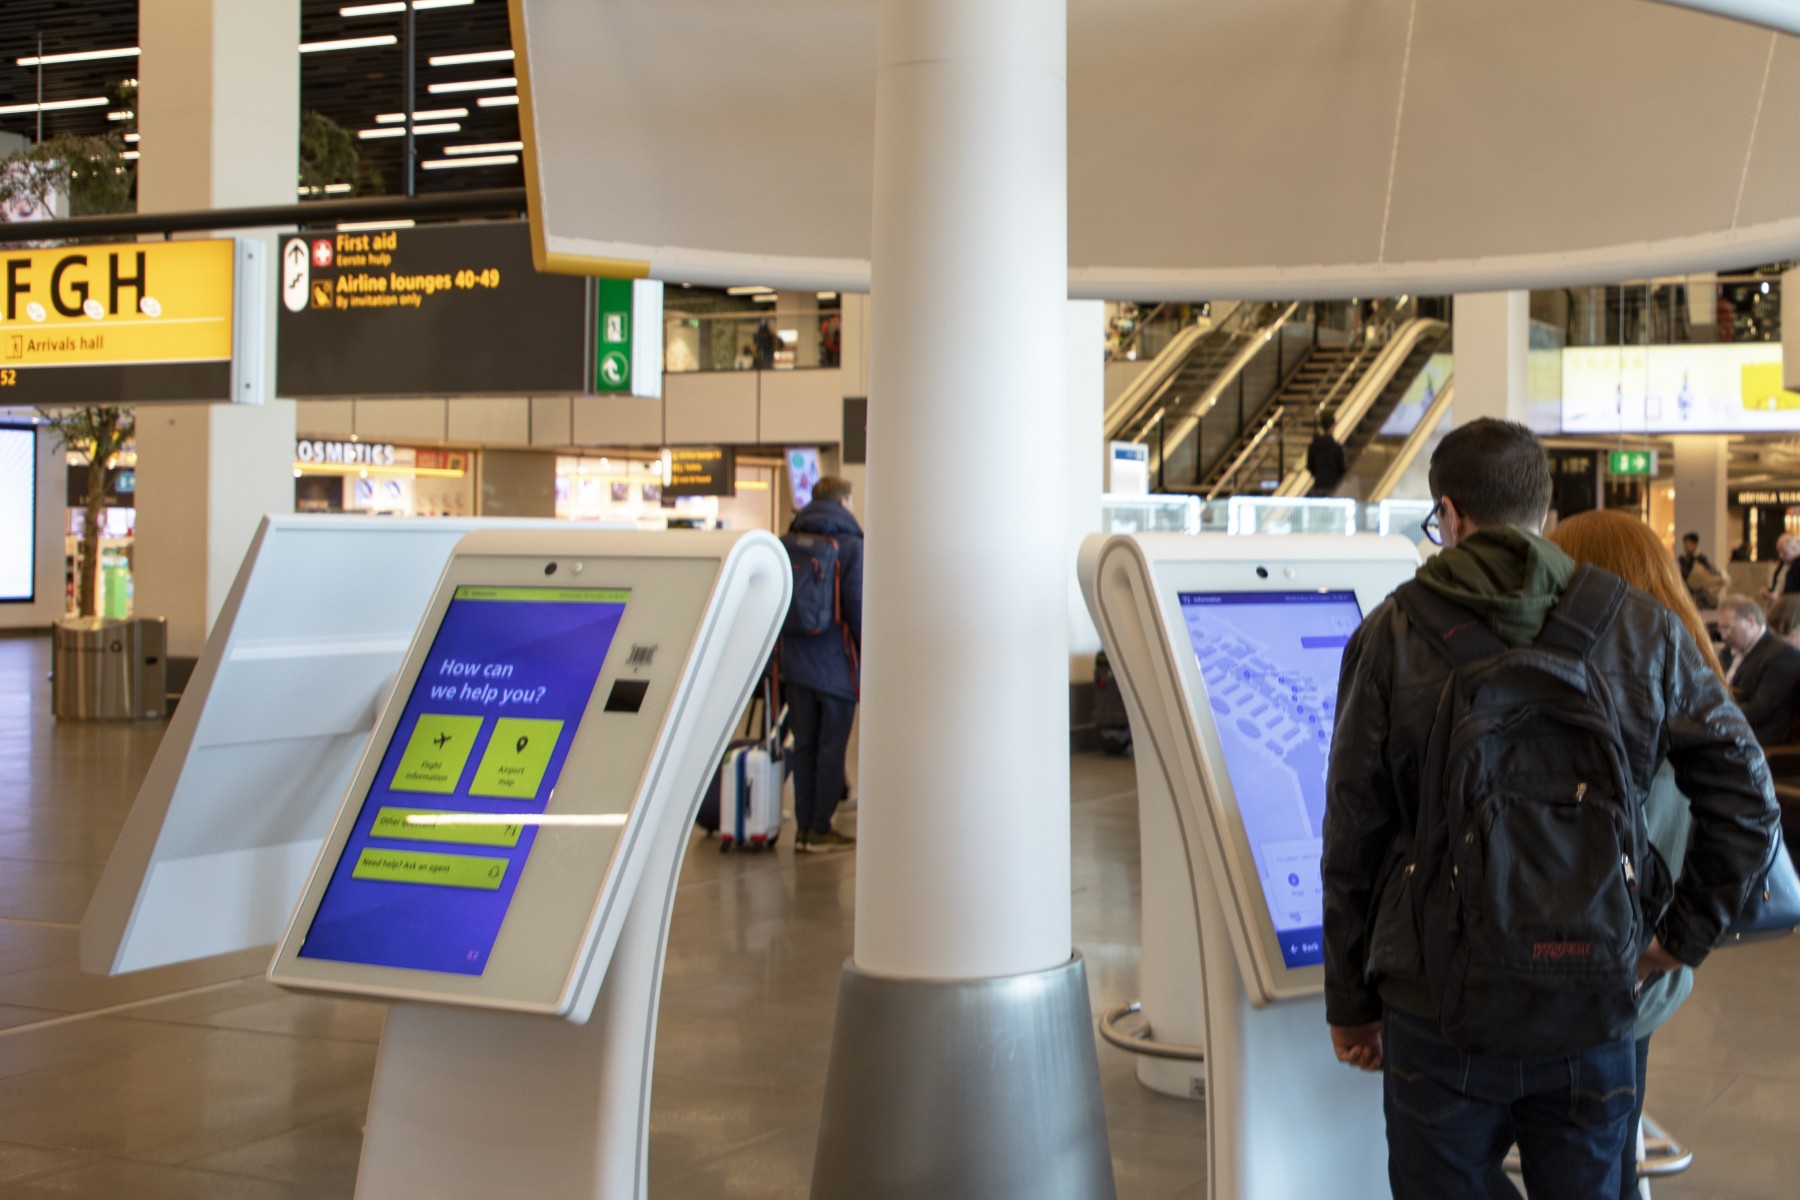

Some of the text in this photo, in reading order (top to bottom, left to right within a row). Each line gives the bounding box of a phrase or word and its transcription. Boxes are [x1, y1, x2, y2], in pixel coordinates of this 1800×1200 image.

[336, 230, 397, 252] First aid
[336, 252, 392, 267] Eerste hulp
[6, 251, 146, 320] F G H
[336, 268, 500, 294] Airline lounges 40-49
[350, 294, 398, 307] invitation
[399, 292, 422, 308] only
[27, 335, 104, 352] Arrivals hall
[439, 659, 514, 679] How can
[430, 683, 547, 706] we help you?
[421, 760, 442, 771] Flight
[498, 765, 525, 776] Airport
[405, 772, 448, 782] information
[498, 779, 515, 788] map
[380, 816, 400, 826] Other
[363, 858, 382, 869] Need
[383, 860, 402, 872] help?
[403, 862, 418, 870] Ask
[429, 865, 451, 874] agent
